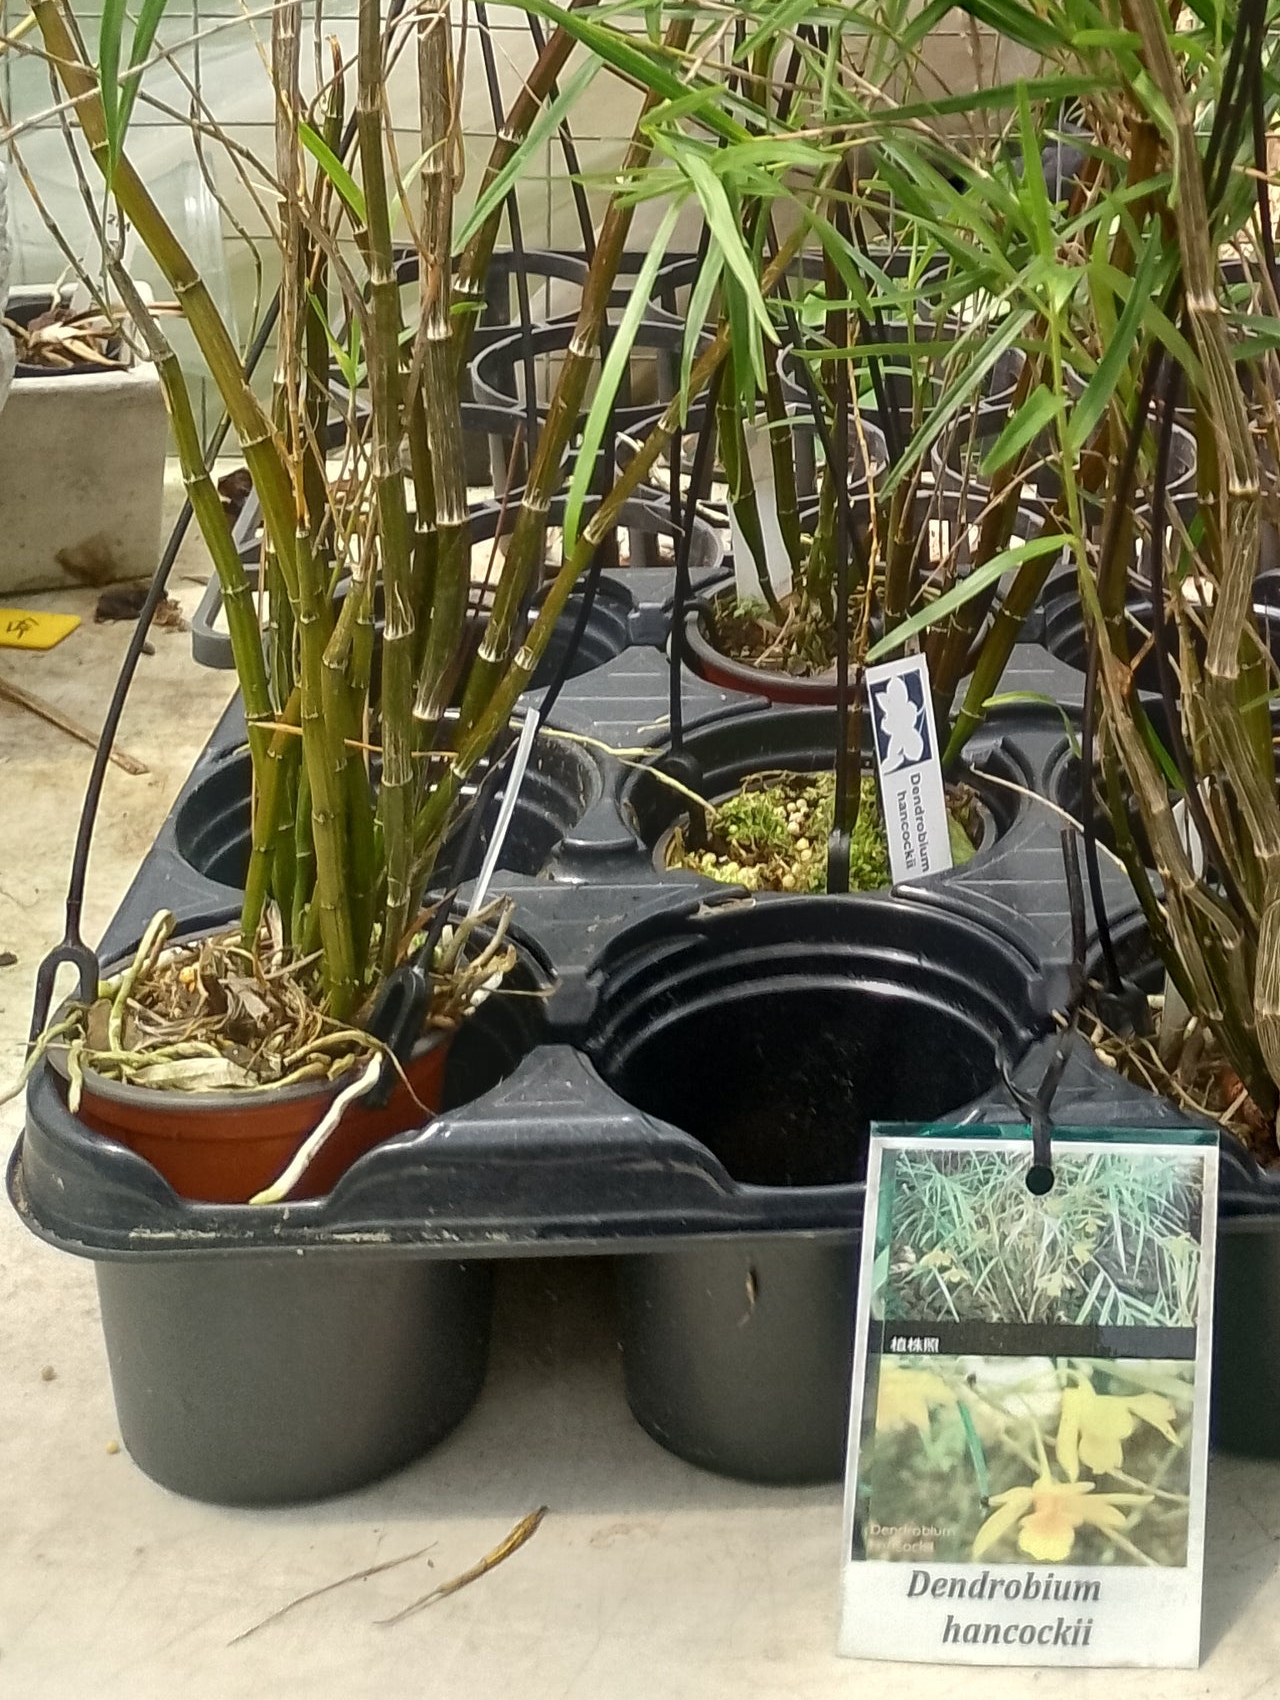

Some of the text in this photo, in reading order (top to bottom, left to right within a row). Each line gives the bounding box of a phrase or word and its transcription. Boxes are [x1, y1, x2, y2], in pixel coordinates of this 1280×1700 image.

[897, 791, 916, 869] hancockii
[911, 773, 930, 873] Dendrobium
[890, 1336, 940, 1353] 植株照
[906, 1569, 1101, 1602] Dendrobium
[941, 1613, 1095, 1648] hancockii
